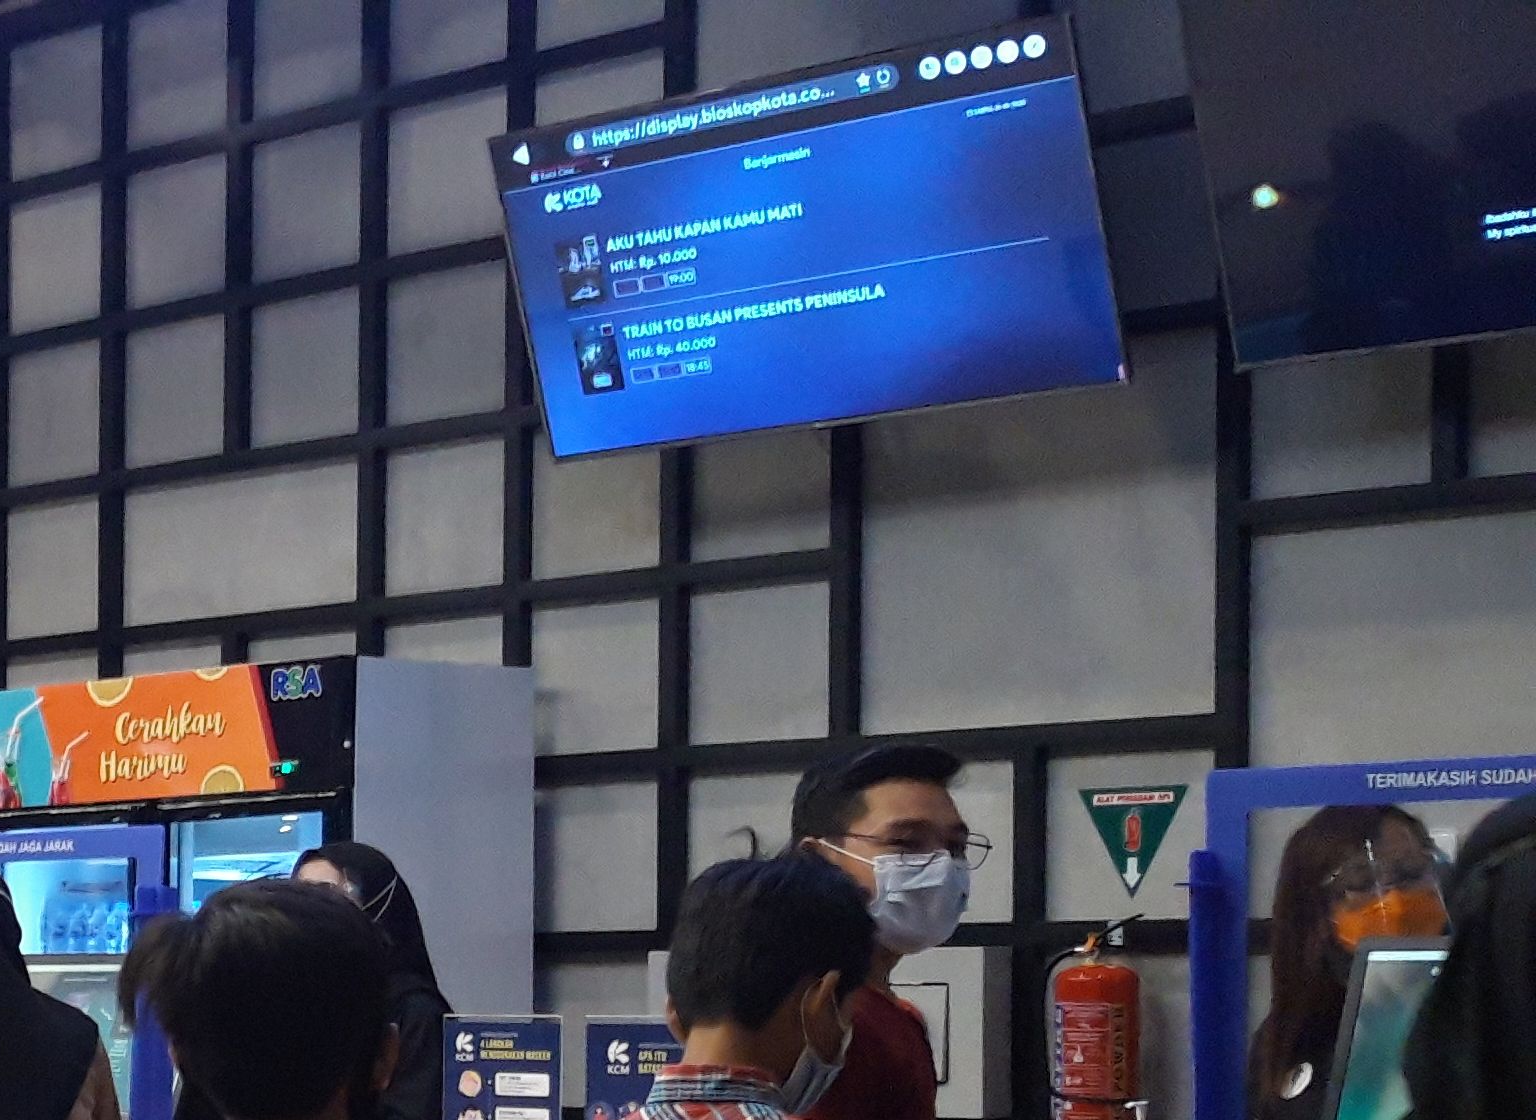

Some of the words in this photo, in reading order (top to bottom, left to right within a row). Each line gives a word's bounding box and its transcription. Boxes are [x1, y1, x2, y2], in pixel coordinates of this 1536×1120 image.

[563, 184, 602, 205] KOTA
[606, 233, 634, 252] AKU
[635, 227, 673, 247] TAHU
[675, 215, 721, 240] KAPAN
[723, 208, 766, 231] KAMU
[767, 202, 804, 222] MATI
[622, 322, 663, 340] TRAIN
[664, 317, 684, 334] TO
[686, 309, 733, 331] BUSAN
[733, 298, 804, 322] PRESENTS
[805, 283, 886, 310] PENINSULA
[270, 665, 323, 702] RSA
[114, 700, 227, 746] Cerahkan
[99, 750, 189, 783] Harimu
[1366, 770, 1478, 789] TERIMAKASIH
[1480, 767, 1536, 786] SUDAH
[607, 1064, 630, 1075] KCM
